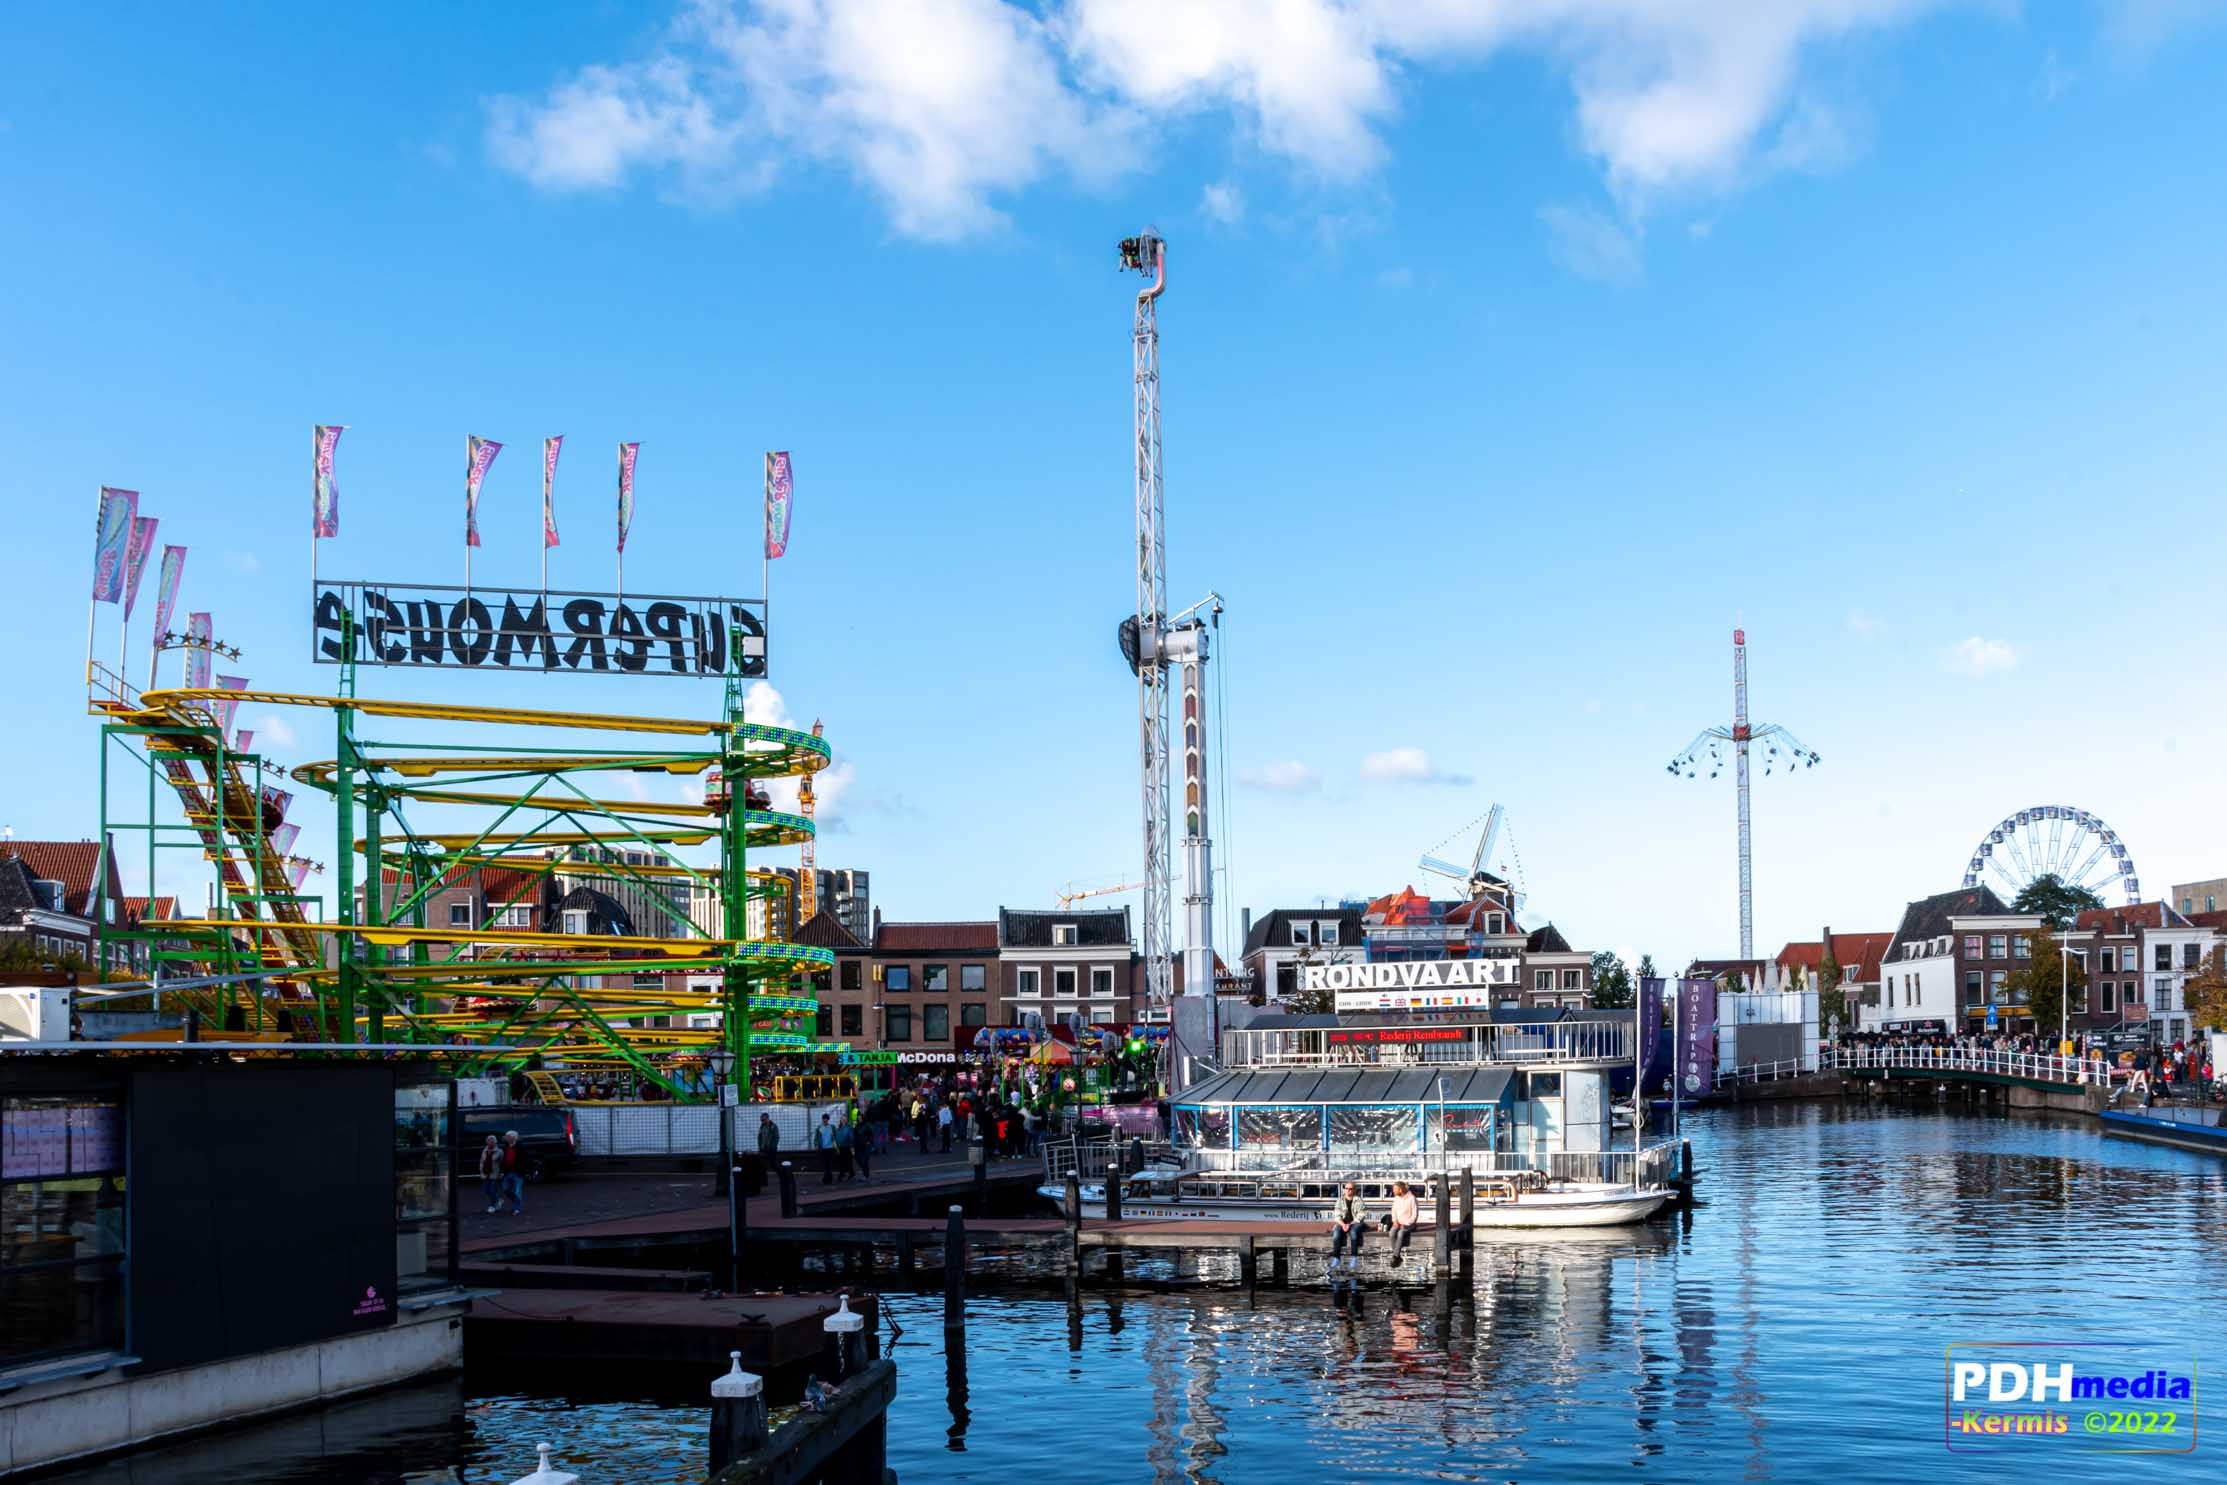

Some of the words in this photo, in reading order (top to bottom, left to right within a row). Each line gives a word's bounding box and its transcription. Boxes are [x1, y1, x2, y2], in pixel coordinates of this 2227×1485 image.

[1305, 959, 1520, 990] RONDVAART
[1380, 1030, 1411, 1043] Rederij
[858, 1053, 892, 1063] TANJA
